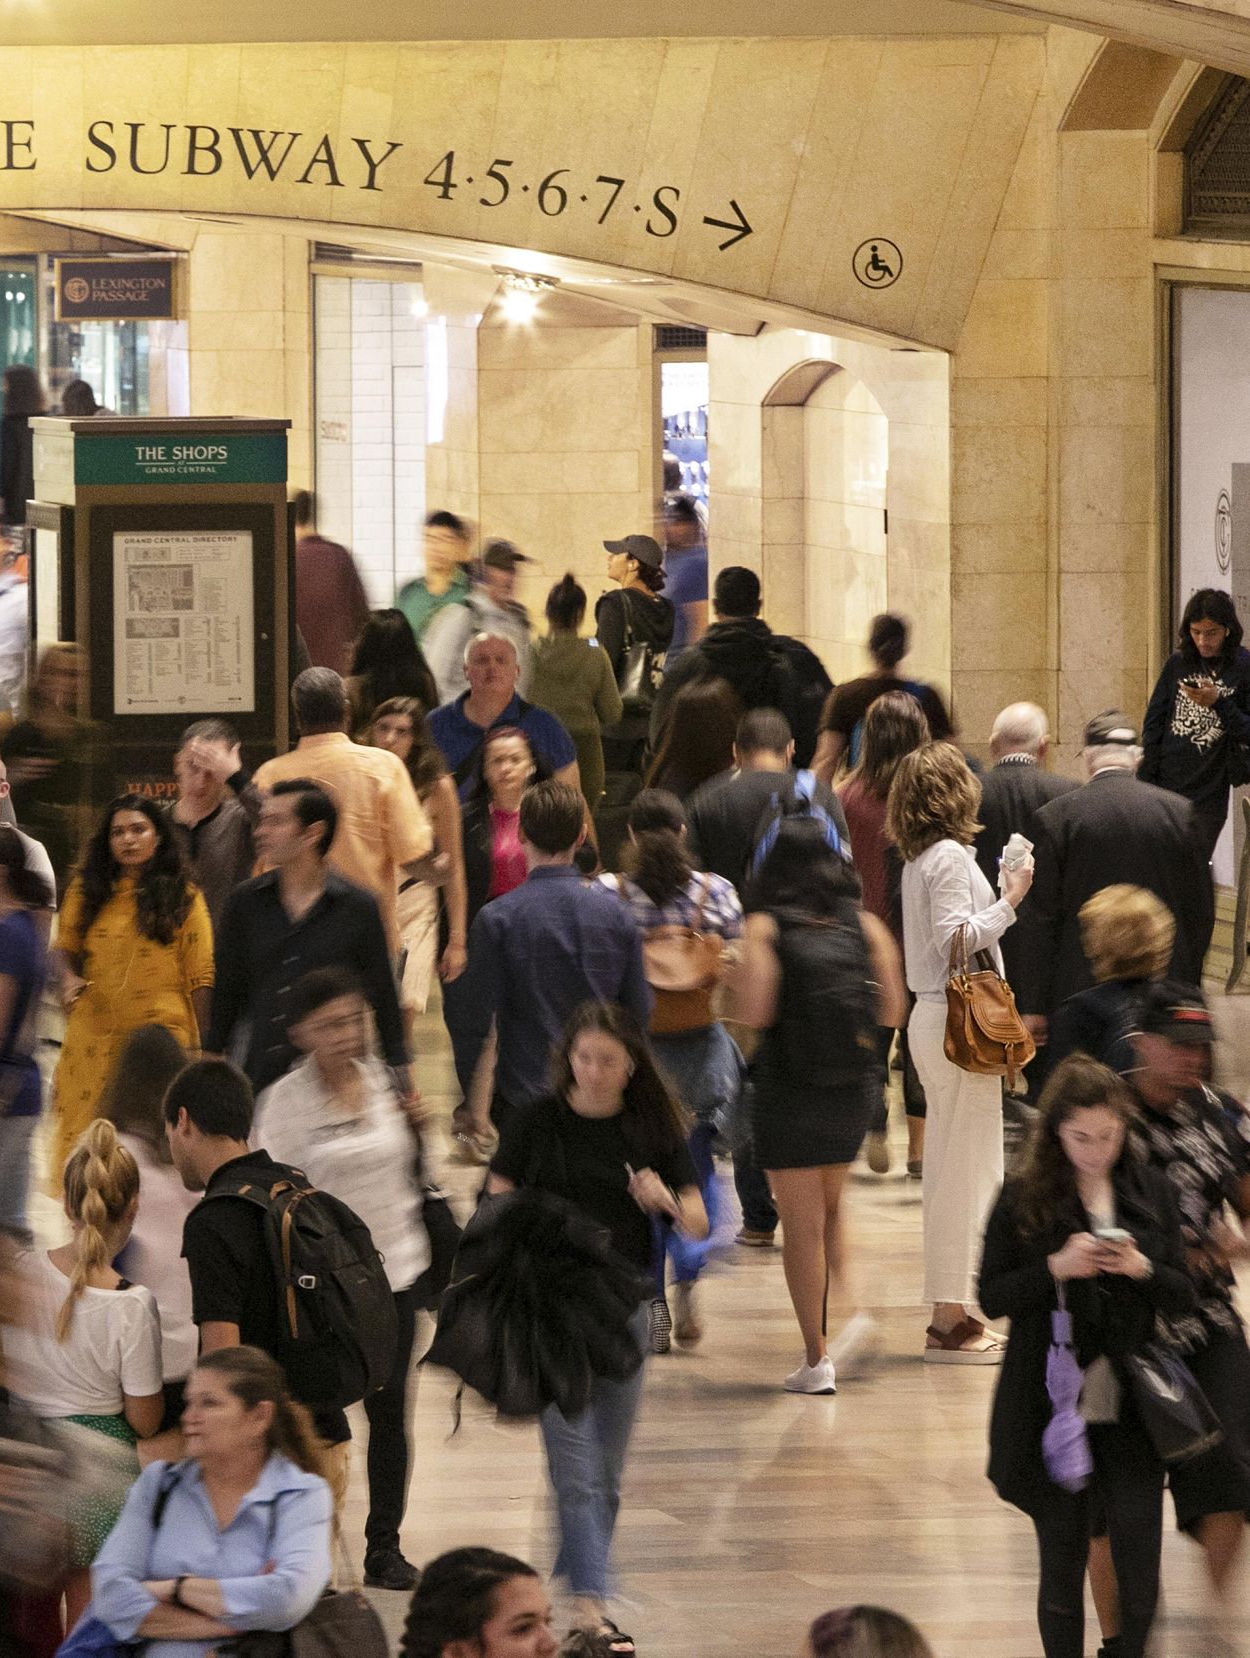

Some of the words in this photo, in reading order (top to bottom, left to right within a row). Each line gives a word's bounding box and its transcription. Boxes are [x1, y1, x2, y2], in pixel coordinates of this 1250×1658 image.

[85, 121, 404, 192] SUBWAY
[91, 278, 166, 290] LEXINGTON
[91, 290, 150, 301] PASSAGE
[135, 446, 167, 460] THE
[172, 445, 228, 460] SHOPS
[145, 466, 175, 474] GRAND
[193, 535, 238, 543] DIRECTORY
